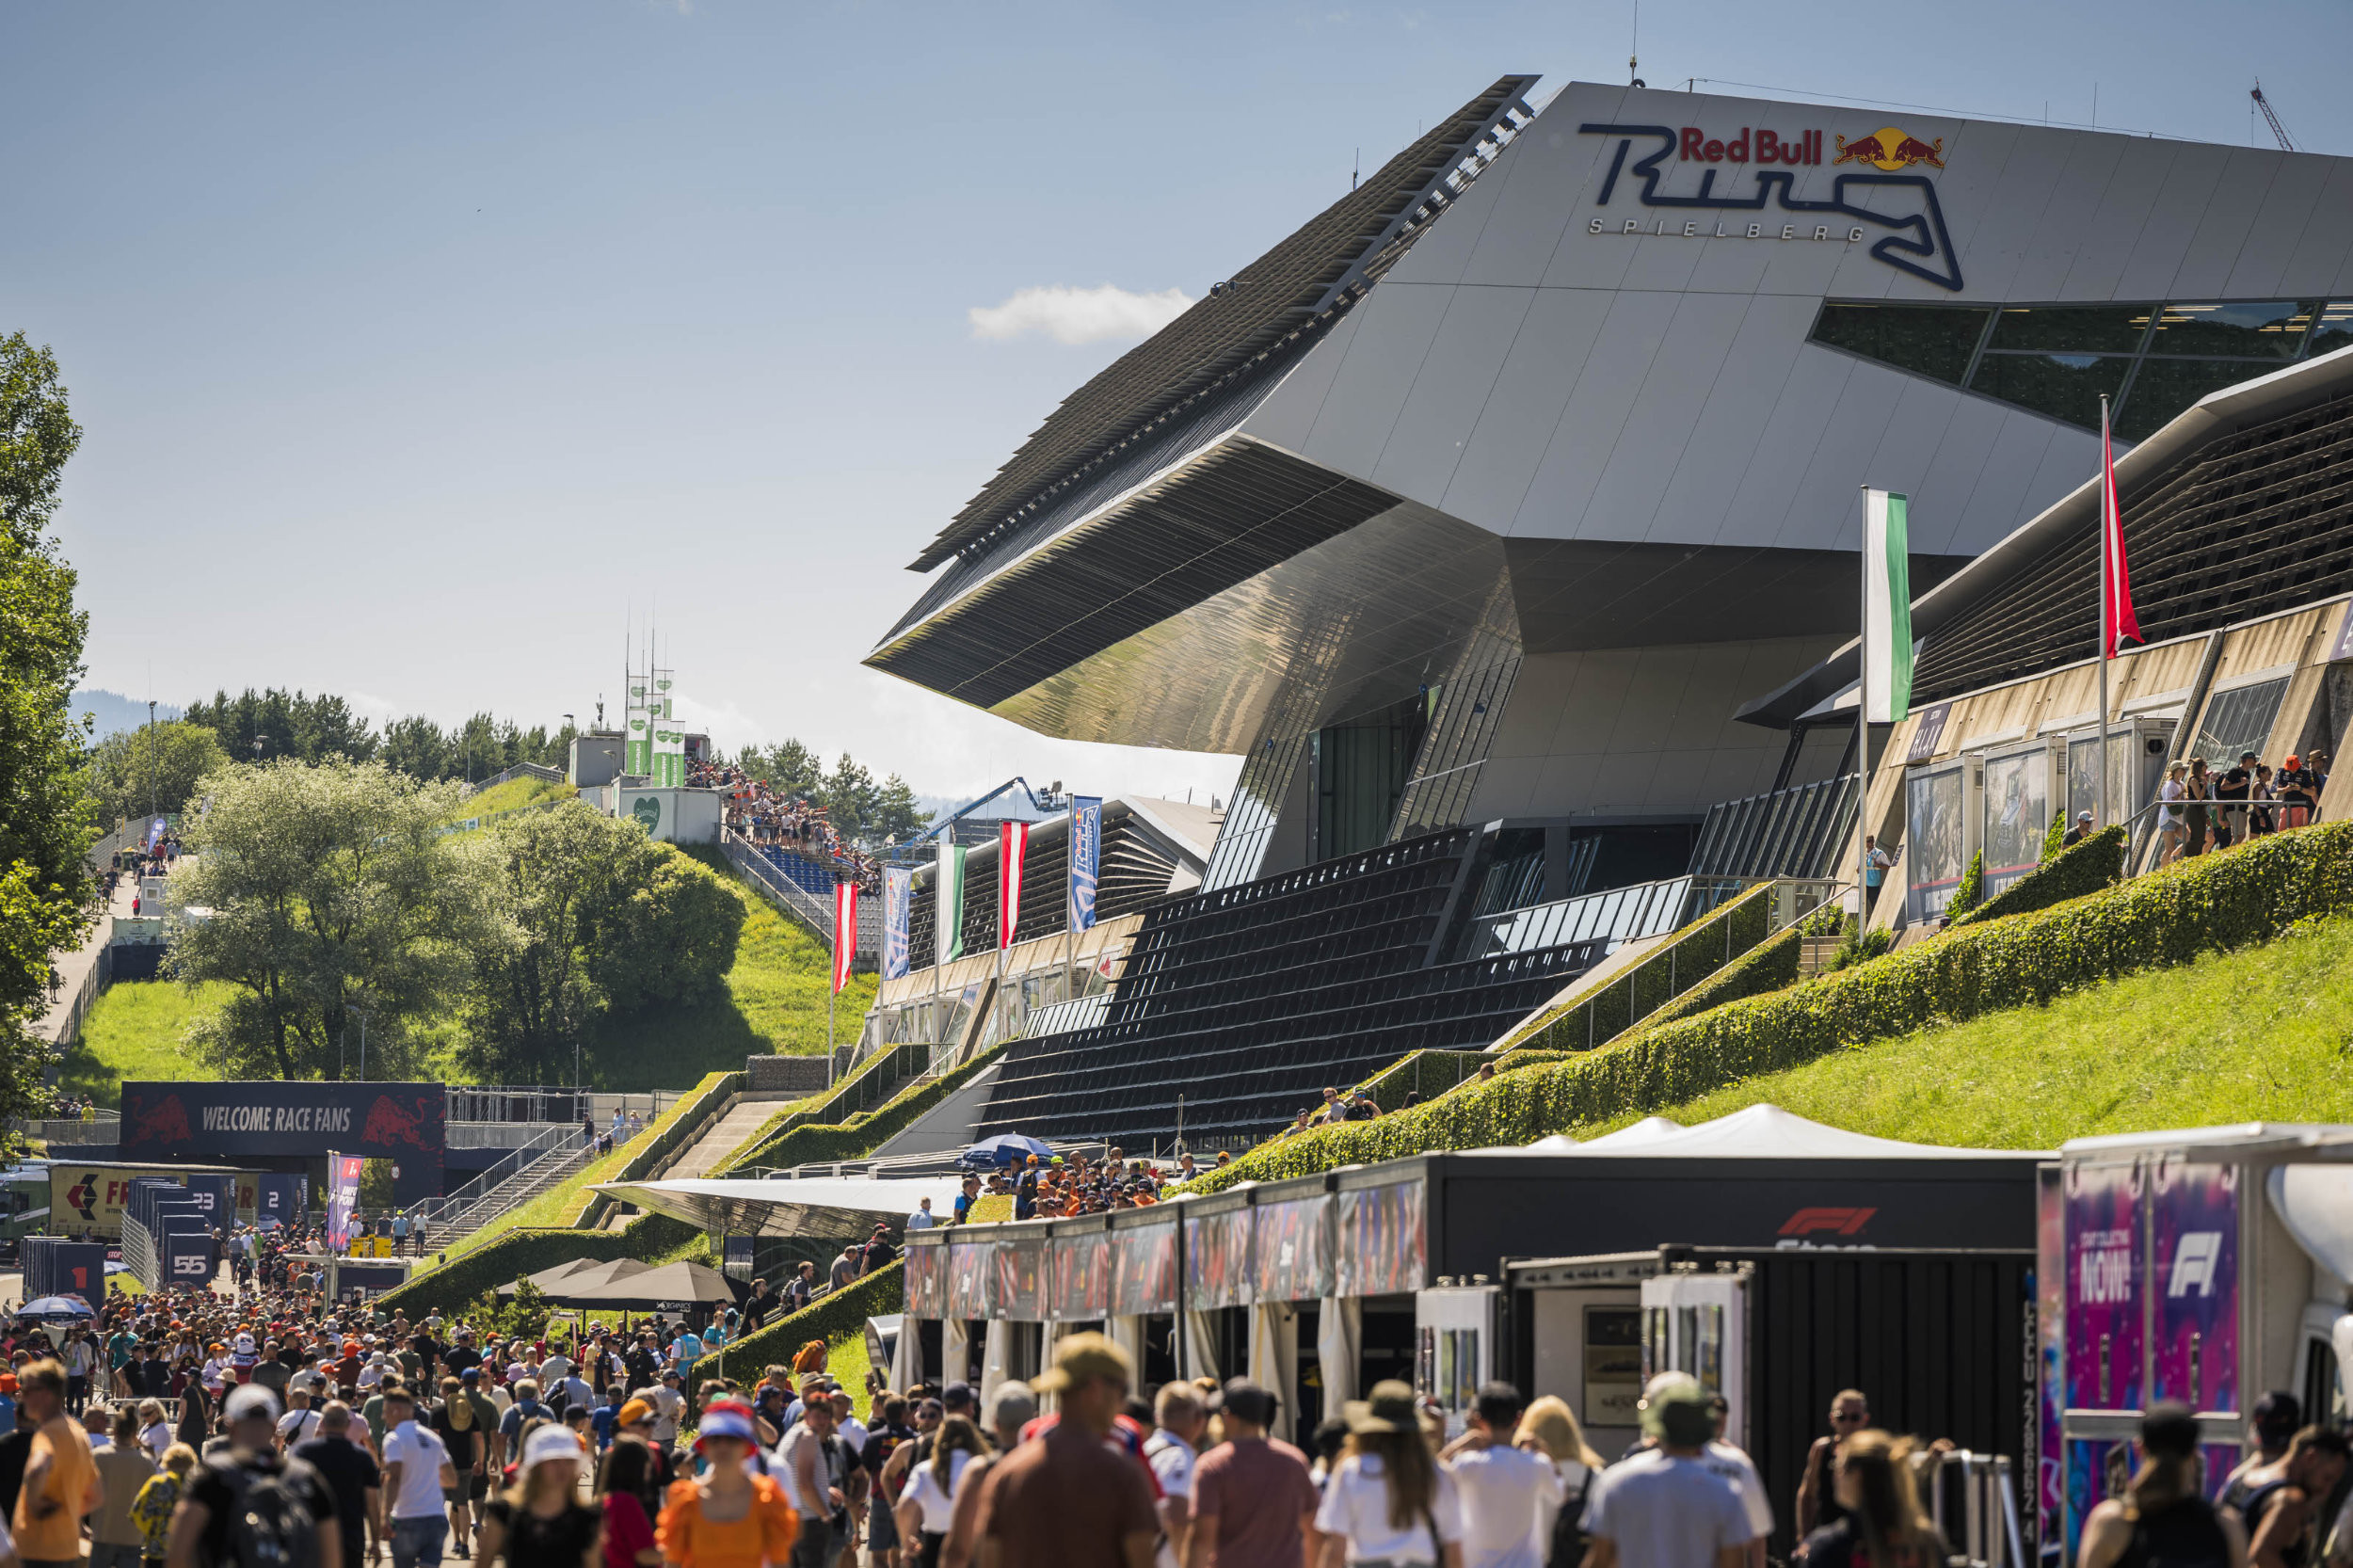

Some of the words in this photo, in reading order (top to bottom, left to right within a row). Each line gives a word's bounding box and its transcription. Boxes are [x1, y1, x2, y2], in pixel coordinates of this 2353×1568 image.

[1680, 128, 1750, 163] Red
[1756, 129, 1822, 166] Bull
[1589, 218, 1865, 242] SPIELBERG
[202, 1106, 272, 1130] WELCOME
[274, 1107, 312, 1131] RACE
[314, 1107, 351, 1132] FANS
[268, 1192, 280, 1208] 2
[173, 1255, 206, 1274] 55
[72, 1267, 88, 1288] 1
